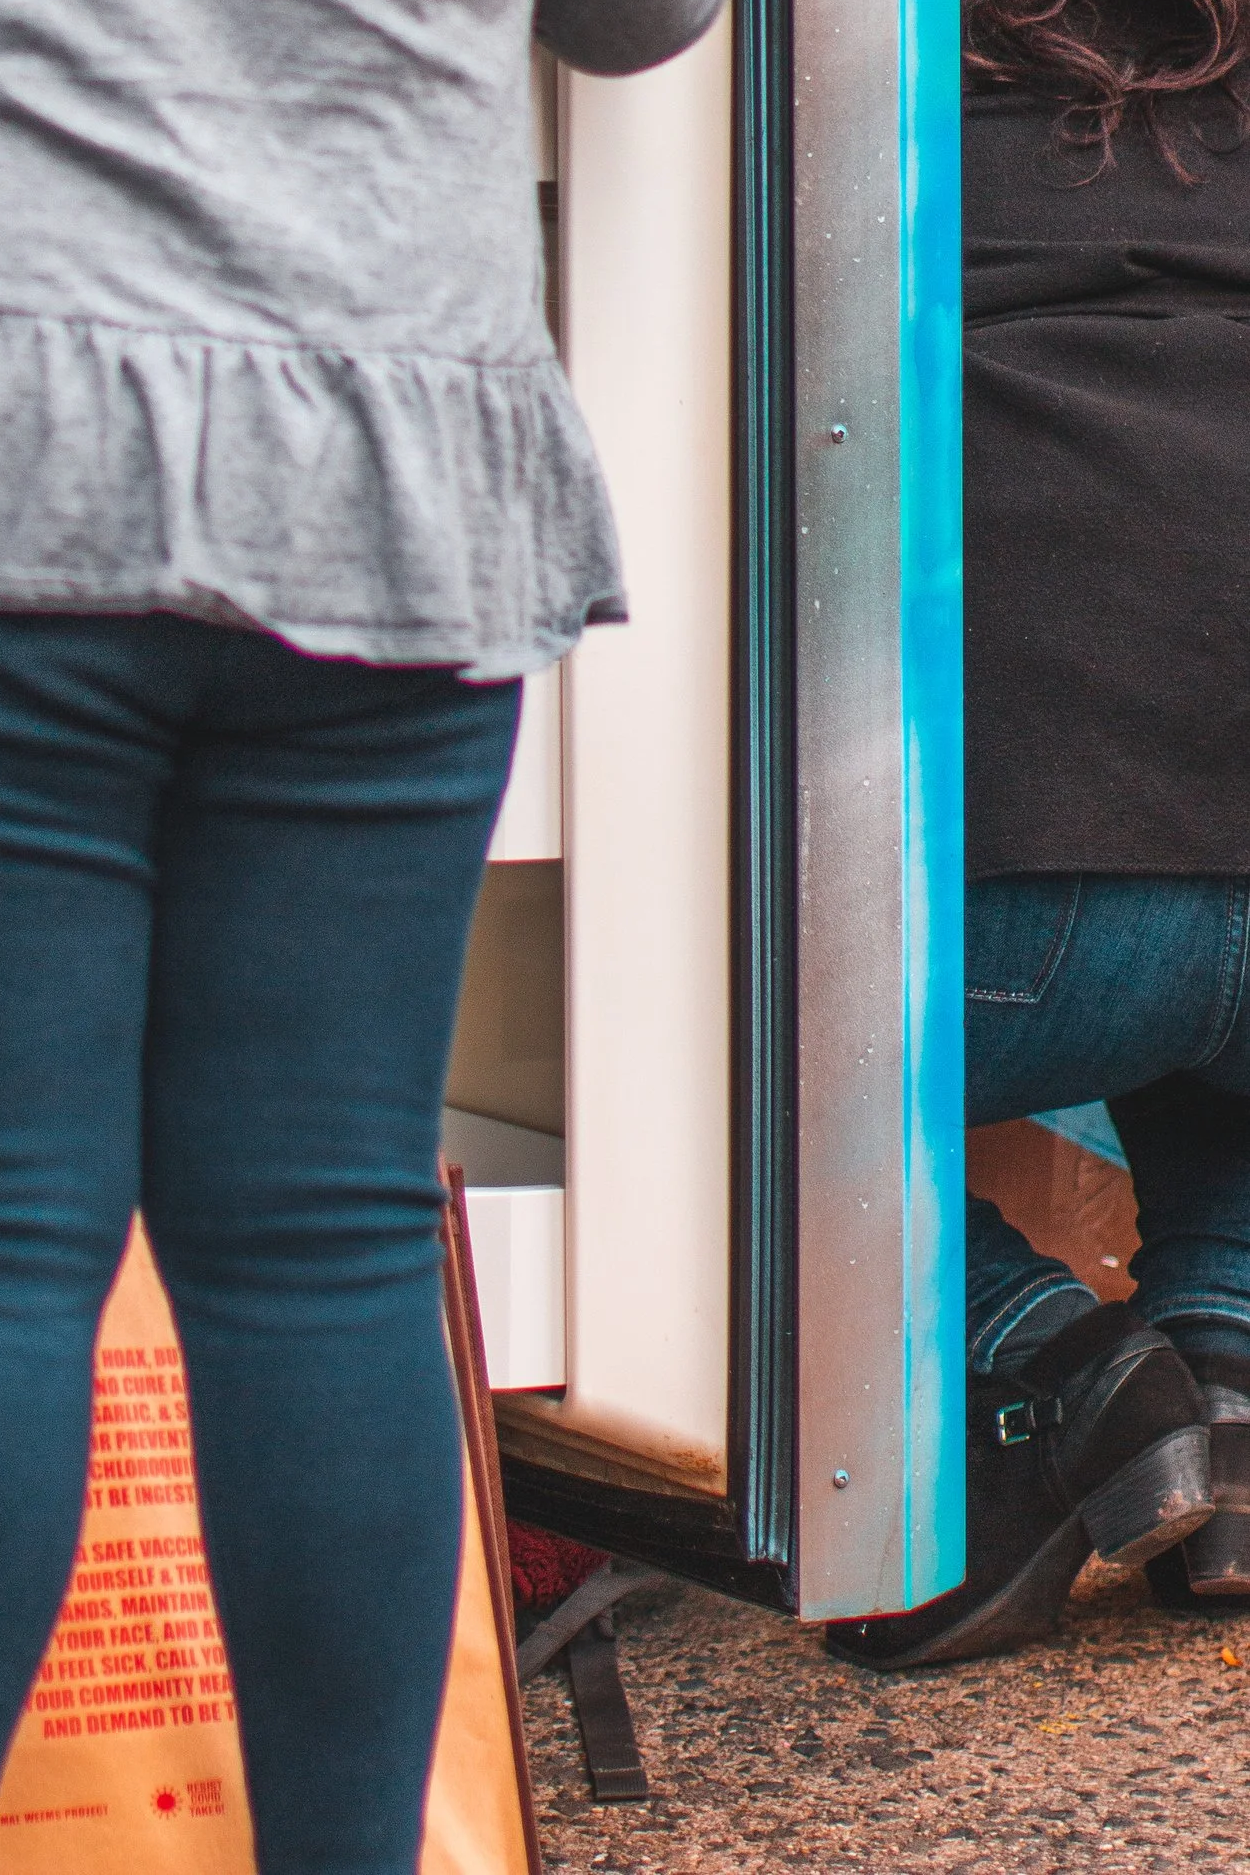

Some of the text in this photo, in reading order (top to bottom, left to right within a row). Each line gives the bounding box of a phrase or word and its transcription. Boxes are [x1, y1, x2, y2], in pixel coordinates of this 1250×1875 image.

[154, 1346, 181, 1368] BU
[123, 1374, 167, 1396] CURE
[109, 1483, 195, 1508] BE INGEST
[92, 1539, 136, 1564] SAFE
[139, 1536, 205, 1560] VACCIN
[72, 1563, 209, 1593] OURSELF & THO
[60, 1591, 209, 1624] ANDS, MAINTAIN
[55, 1627, 106, 1653] YOUR
[163, 1619, 199, 1642] AND
[58, 1658, 98, 1681] FEEL
[156, 1648, 199, 1671] CALL
[79, 1677, 194, 1707] COMMUNITY
[44, 1702, 222, 1740] AND DEMAND TO BE
[64, 1803, 109, 1819] PROJECT
